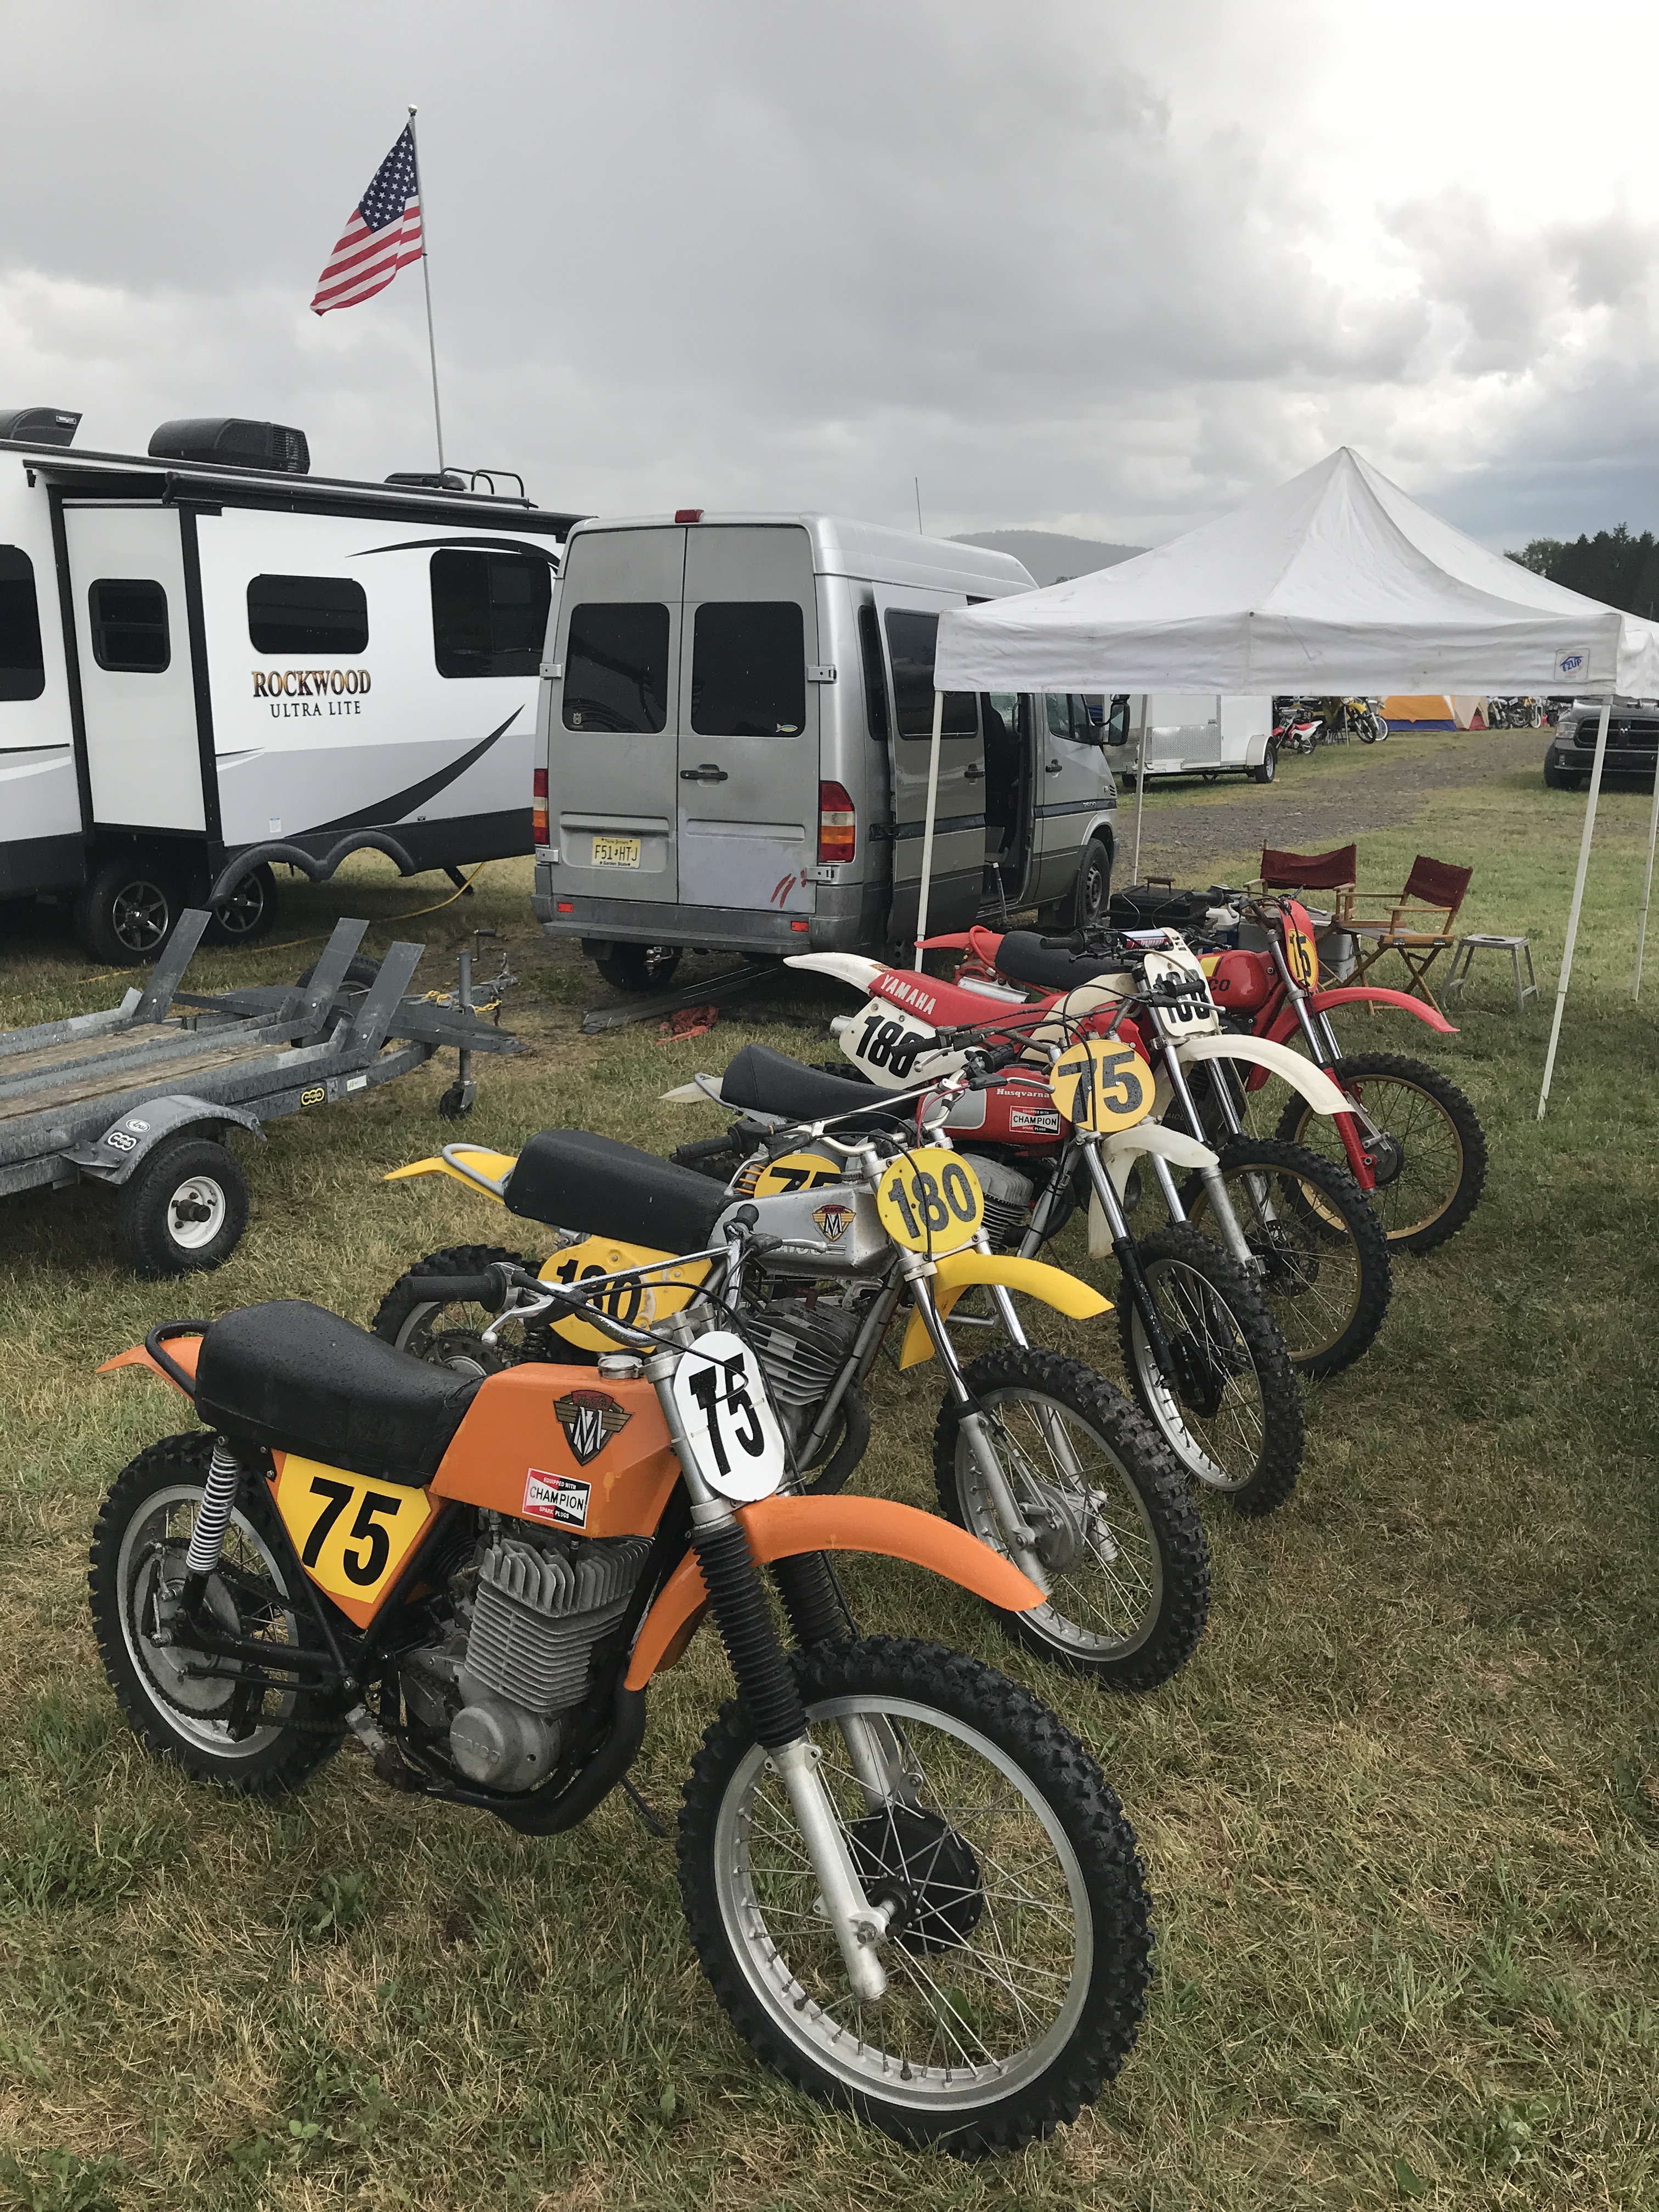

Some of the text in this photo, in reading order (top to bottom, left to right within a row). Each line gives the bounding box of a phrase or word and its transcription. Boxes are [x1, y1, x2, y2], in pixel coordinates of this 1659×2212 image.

[251, 669, 371, 697] ROCKWOOD
[270, 701, 361, 718] ULTRA LITE
[880, 974, 936, 1015] YAMAHA
[996, 1088, 1050, 1098] Husqvarna
[1058, 1051, 1143, 1124] 75
[1013, 1115, 1057, 1126] CHAMPION
[888, 1163, 977, 1239] 180
[689, 1352, 765, 1477] 75
[543, 1477, 565, 1487] EQUIPPED
[529, 1486, 584, 1511] CHAMPION
[539, 1506, 569, 1519] SPARK PLUGS
[302, 1476, 403, 1586] 75
